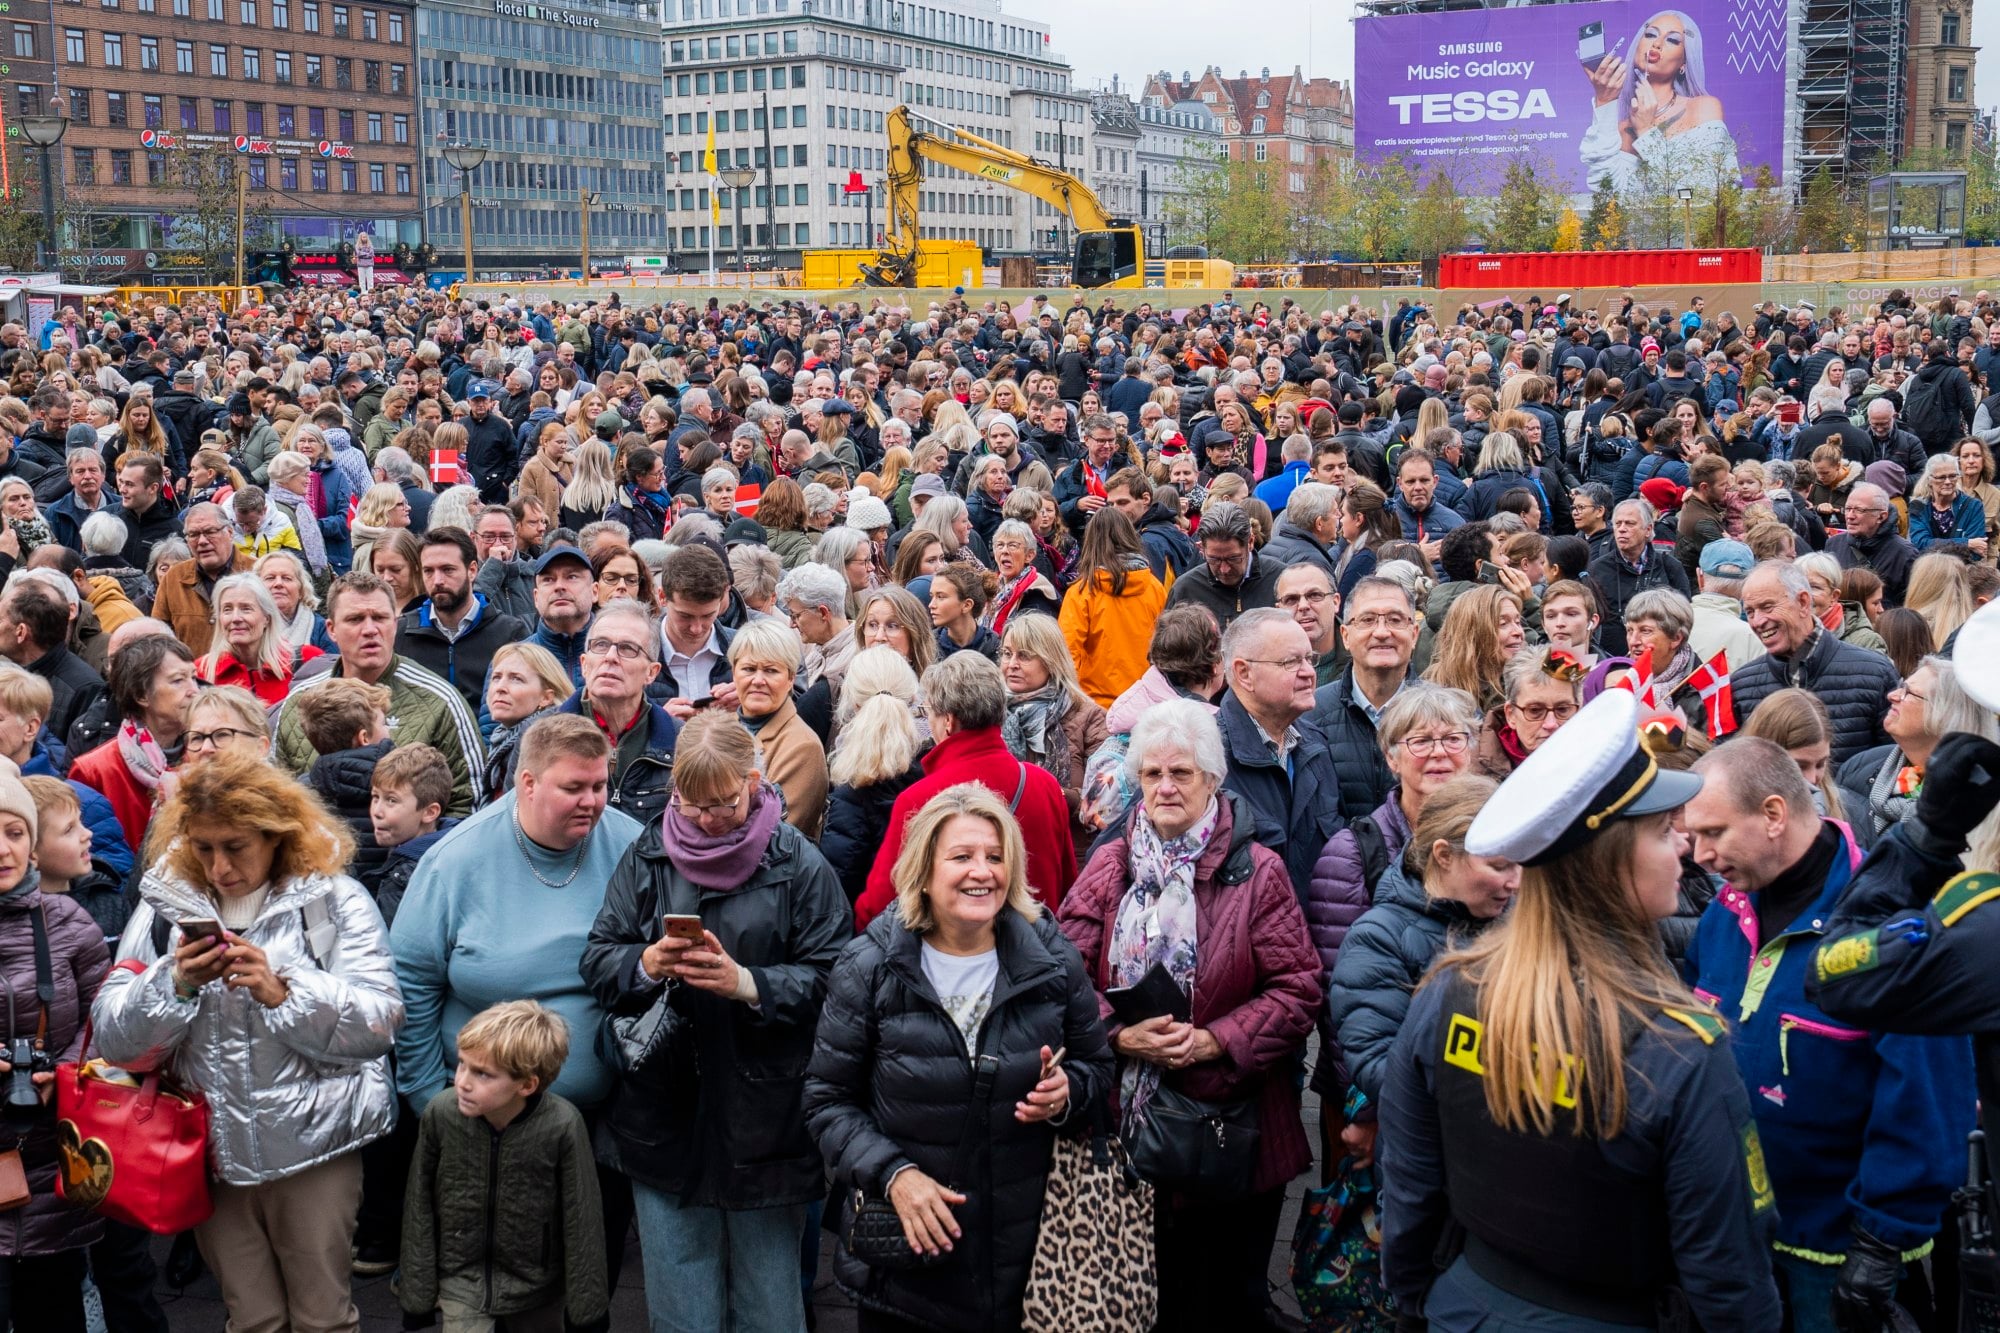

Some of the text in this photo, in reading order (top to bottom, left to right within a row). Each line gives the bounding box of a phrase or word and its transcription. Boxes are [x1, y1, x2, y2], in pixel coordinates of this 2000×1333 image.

[496, 1, 599, 27] Hotel The Square
[1439, 41, 1503, 56] SAMSUNG
[1408, 60, 1534, 81] Music Galaxy
[1388, 88, 1557, 125] TESSA
[1374, 137, 1397, 146] Gratis
[466, 292, 549, 303] COPEAGEN
[1848, 286, 1962, 301] COPEHAGEN
